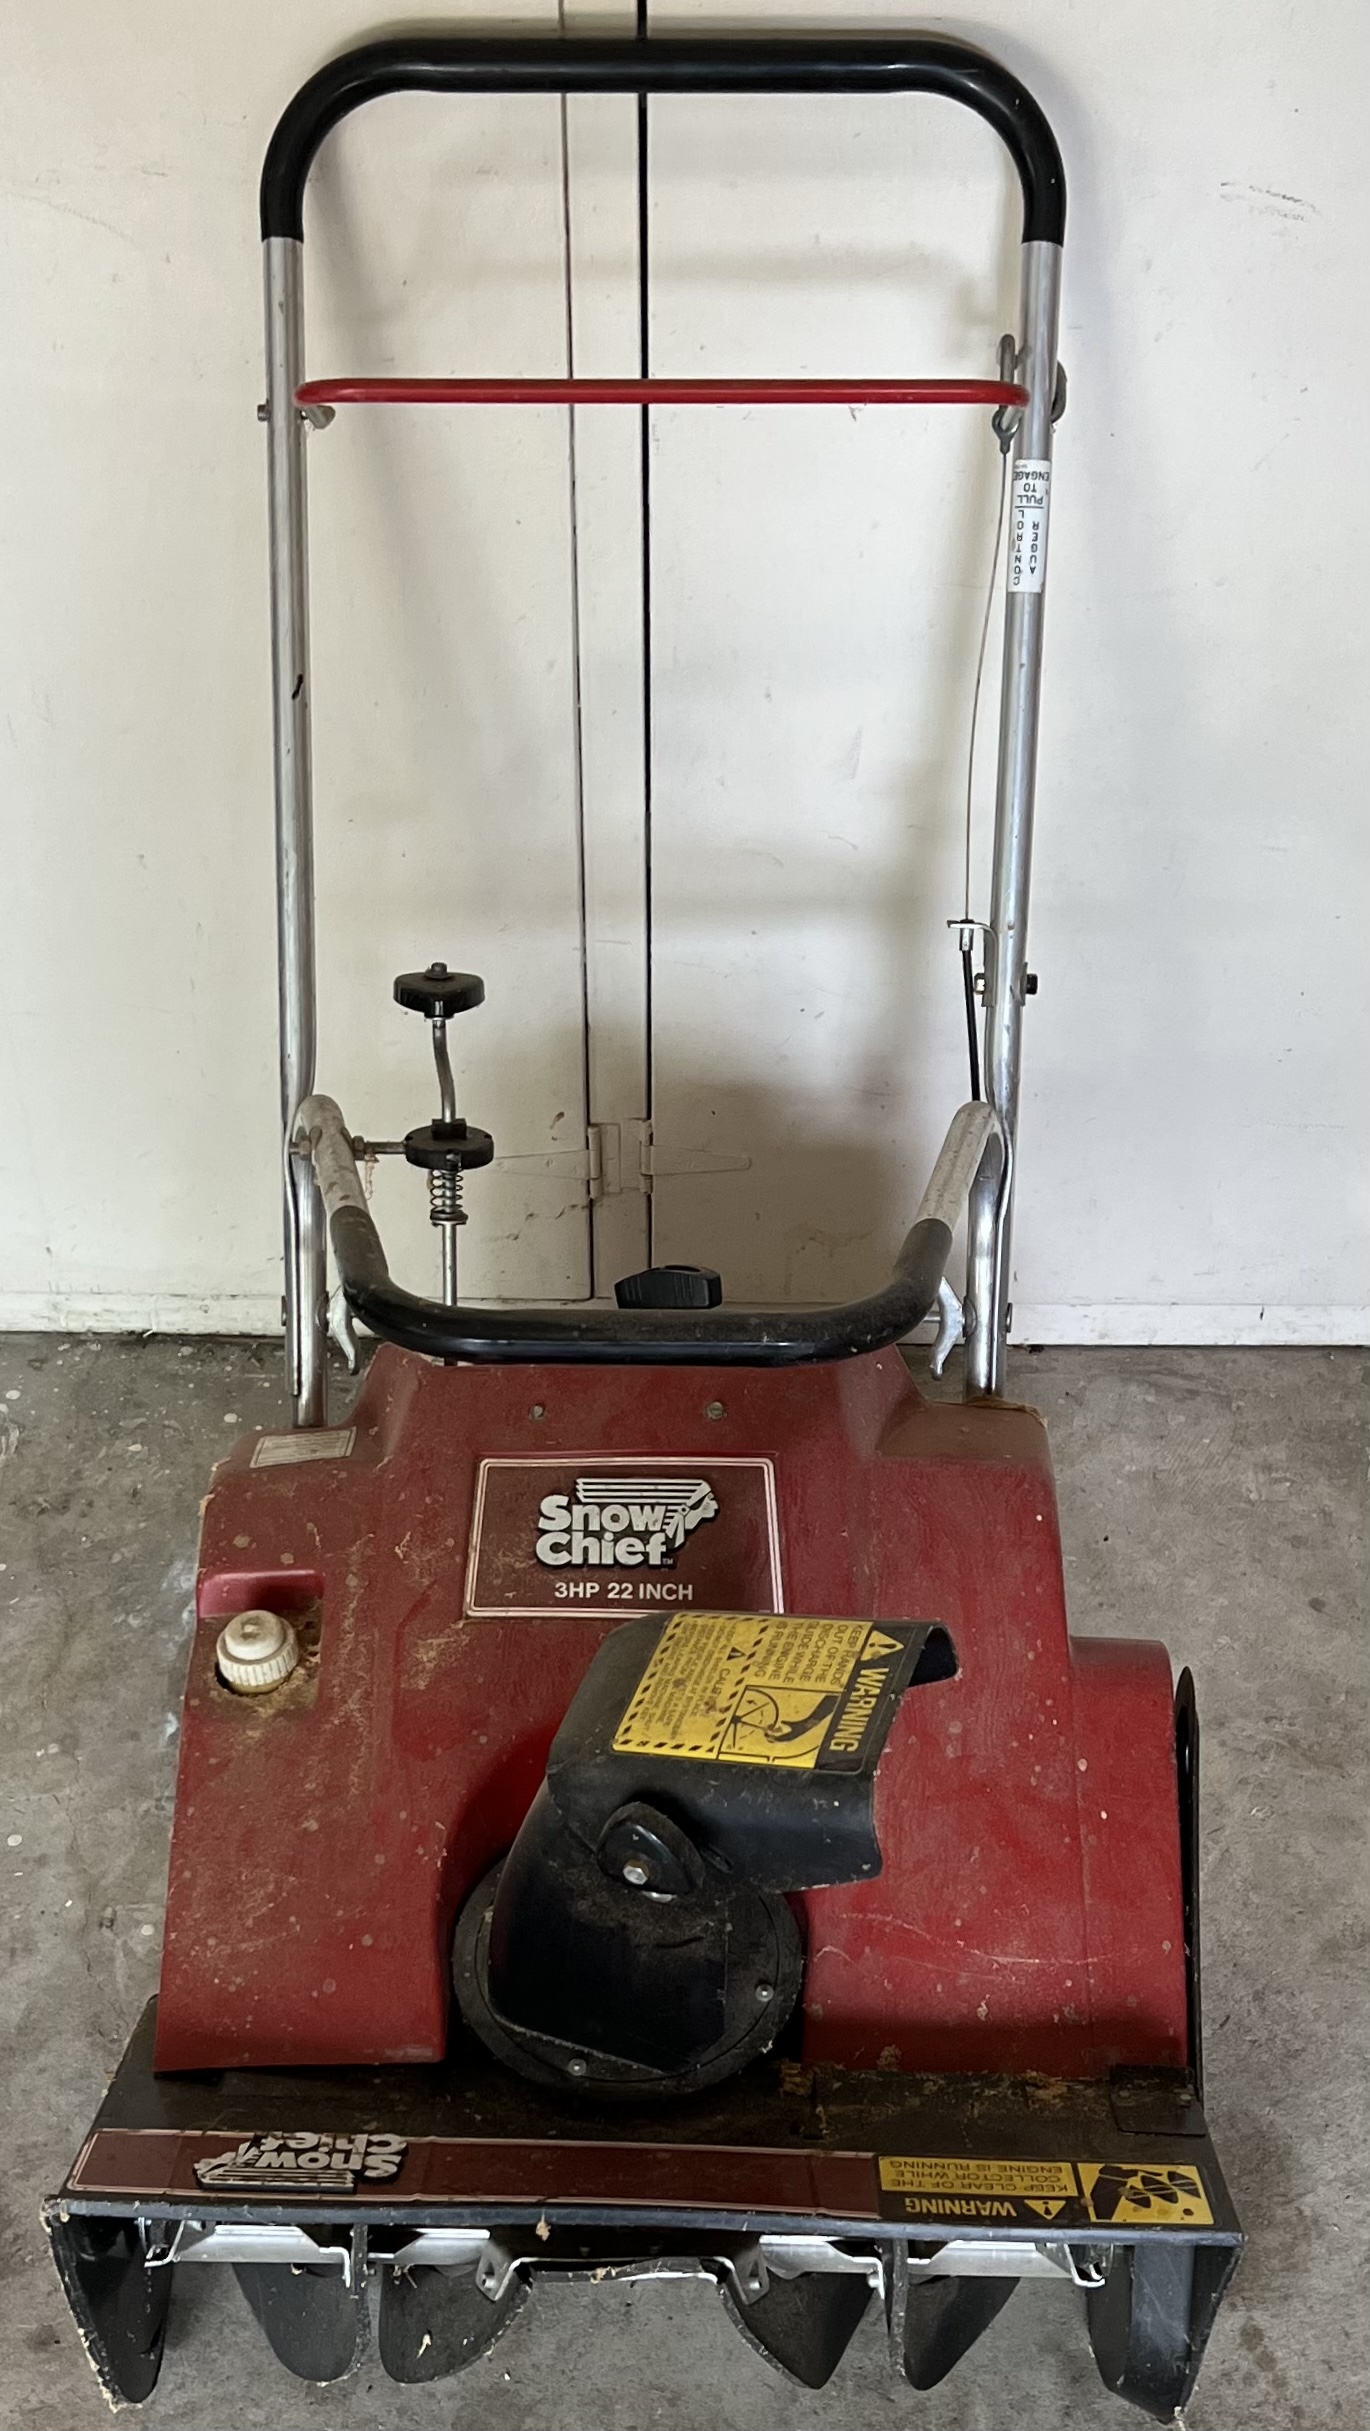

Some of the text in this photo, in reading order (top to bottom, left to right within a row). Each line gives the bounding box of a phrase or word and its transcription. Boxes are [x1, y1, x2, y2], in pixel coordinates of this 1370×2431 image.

[1013, 471, 1050, 481] ENGAGE
[1023, 482, 1037, 493] TO
[1017, 494, 1044, 505] PULL
[538, 1494, 667, 1531] Snow
[535, 1531, 667, 1565] Chief
[554, 1582, 694, 1601] 3HP 22 INCH
[767, 1621, 804, 1680] THE ENGINE
[798, 1623, 834, 1682] DISCHARGE
[813, 1623, 849, 1683] OUT OF THE
[828, 1624, 864, 1686] KEEP HANDS
[781, 1650, 806, 1683] WHILE
[829, 1667, 890, 1752] WARNING
[259, 2131, 408, 2155] Chief
[254, 2151, 402, 2178] Snow
[889, 2160, 1063, 2174] ENGINE IS RUNNING
[895, 2170, 1061, 2183] COLLECTOR WHILE
[891, 2179, 1068, 2193] KEEP CLEAR OF THE
[904, 2197, 1018, 2216] WARNING
